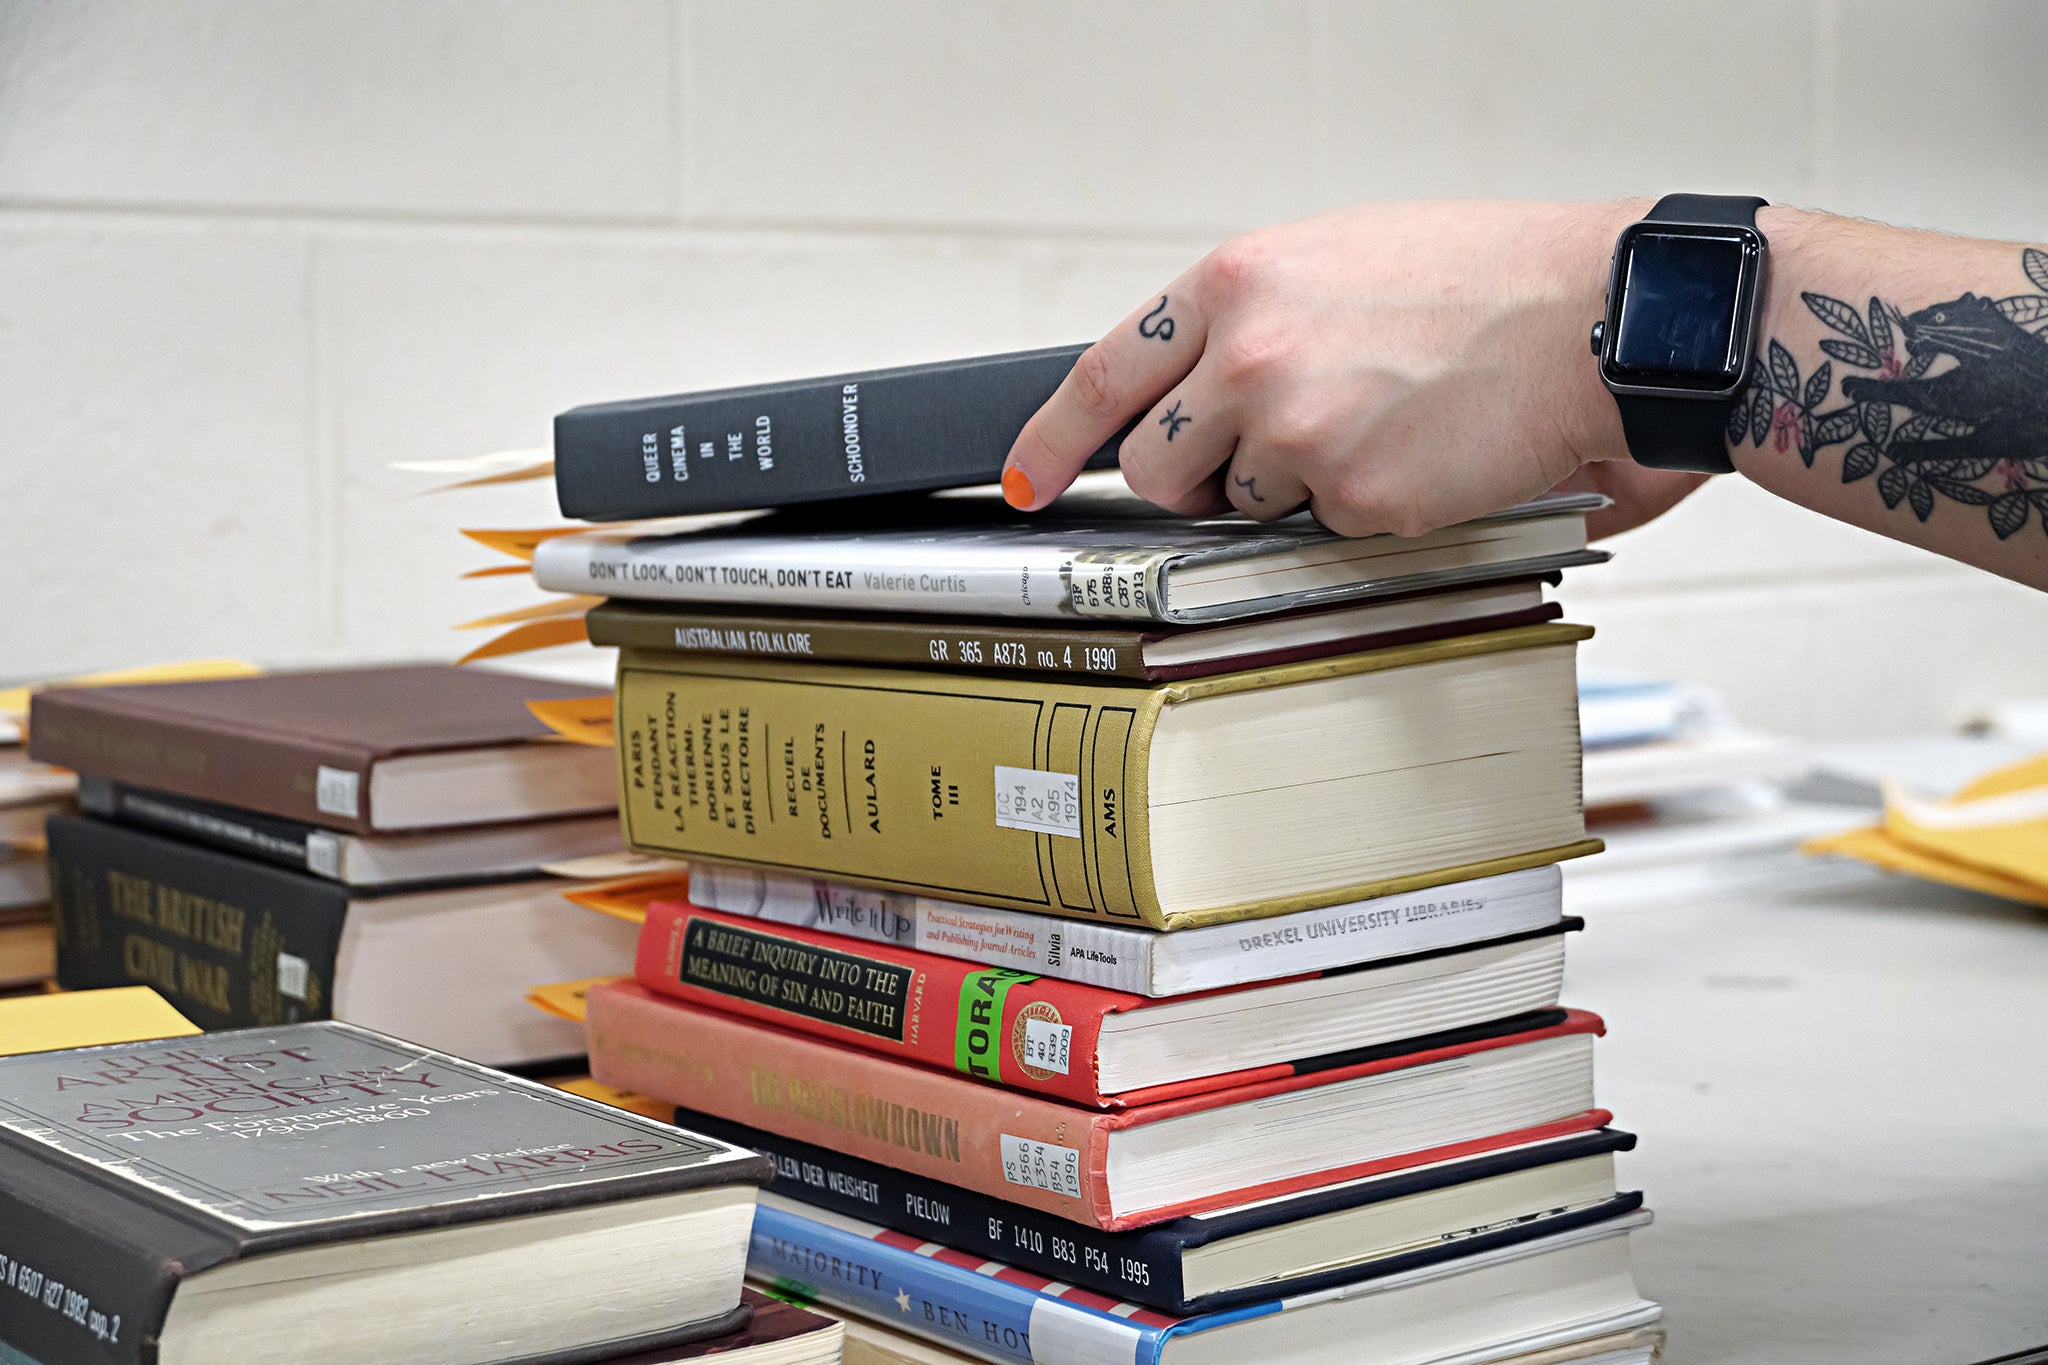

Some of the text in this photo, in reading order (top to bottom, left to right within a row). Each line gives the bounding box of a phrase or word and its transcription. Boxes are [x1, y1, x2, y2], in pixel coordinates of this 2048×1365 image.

[671, 425, 689, 482] CINEMA
[700, 442, 714, 458] IN
[728, 432, 743, 461] THE
[756, 415, 774, 471] WORLD
[843, 383, 865, 483] SCHOONOVER
[642, 432, 661, 483] QUEER
[589, 562, 967, 593] DON'T LOOK, DON'T TOUCH, DON'T EAT Valerie Curtis
[1020, 566, 1031, 606] Chicago
[1072, 584, 1085, 606] BF
[1087, 579, 1100, 607] 575
[1117, 577, 1130, 608] C87
[1134, 571, 1146, 609] 2013
[675, 627, 814, 655] AUSTRALIAN FOLKLORE
[929, 640, 1116, 671] GR 365 A873 no. 4 1990
[630, 729, 645, 788] PARIS
[648, 714, 664, 810] PENDANT
[702, 714, 719, 822] DORIENNE
[719, 708, 736, 829] ET SOUS LE
[739, 707, 756, 835] DIRECTOIRE
[785, 737, 798, 817] RECUEIL
[801, 766, 812, 792] DE
[814, 722, 832, 839] DOCUMENTS
[864, 739, 881, 834] AULARD
[931, 765, 944, 821] TOME
[948, 785, 959, 806] III
[1014, 785, 1026, 815] 194
[673, 806, 685, 832] LA
[998, 793, 1009, 815] DC
[1031, 798, 1043, 821] A2
[1048, 789, 1060, 823] A95
[1065, 781, 1076, 823] 1974
[1104, 788, 1117, 839] AMS
[926, 930, 1036, 959] and Publishing Journal Articles
[927, 911, 1034, 945] Practical Strategies for Writing
[1238, 898, 1485, 952] DREXEL UNIVERSITY LIBRARIES
[692, 926, 899, 995] A BRIEF INQUIRY INTO THE
[1048, 933, 1061, 967] Silvia
[1070, 947, 1085, 960] APA
[687, 954, 895, 1027] MEANING OF SIN AND FAITH
[911, 973, 926, 1045] HARVARD
[1026, 1035, 1034, 1058] BT
[1038, 1041, 1046, 1060] 40
[1048, 1033, 1057, 1064] R39
[1059, 1028, 1070, 1067] 2009
[56, 1047, 319, 1091] ARTIST
[178, 1072, 253, 1087] IN
[76, 1072, 445, 1129] SOCIETY
[83, 1066, 405, 1114] AMERICAN
[107, 1088, 499, 1142] The Formative Years
[263, 1139, 663, 1204] NEIL HARRIS
[303, 1170, 383, 1183] With
[412, 1158, 468, 1171] new
[472, 1144, 575, 1161] Preface
[1006, 1161, 1018, 1182] PS
[1019, 1142, 1034, 1186] 3566
[1035, 1146, 1048, 1189] E354
[1050, 1160, 1063, 1193] B54
[1065, 1152, 1079, 1196] 1996
[802, 1162, 826, 1188] DER
[827, 1170, 880, 1204] WEISHEIT
[906, 1193, 950, 1226] PIELOW
[988, 1217, 1003, 1240] BF
[1014, 1225, 1043, 1254] 1410
[1052, 1236, 1076, 1264] B83
[1085, 1246, 1108, 1274] P54
[1120, 1257, 1150, 1286] 1995
[771, 1237, 882, 1291] MAJORITY
[7, 1260, 18, 1286] N
[18, 1265, 44, 1298] 6507
[62, 1288, 89, 1326] 1982
[110, 1314, 121, 1344] 2
[922, 1300, 968, 1333] BEN
